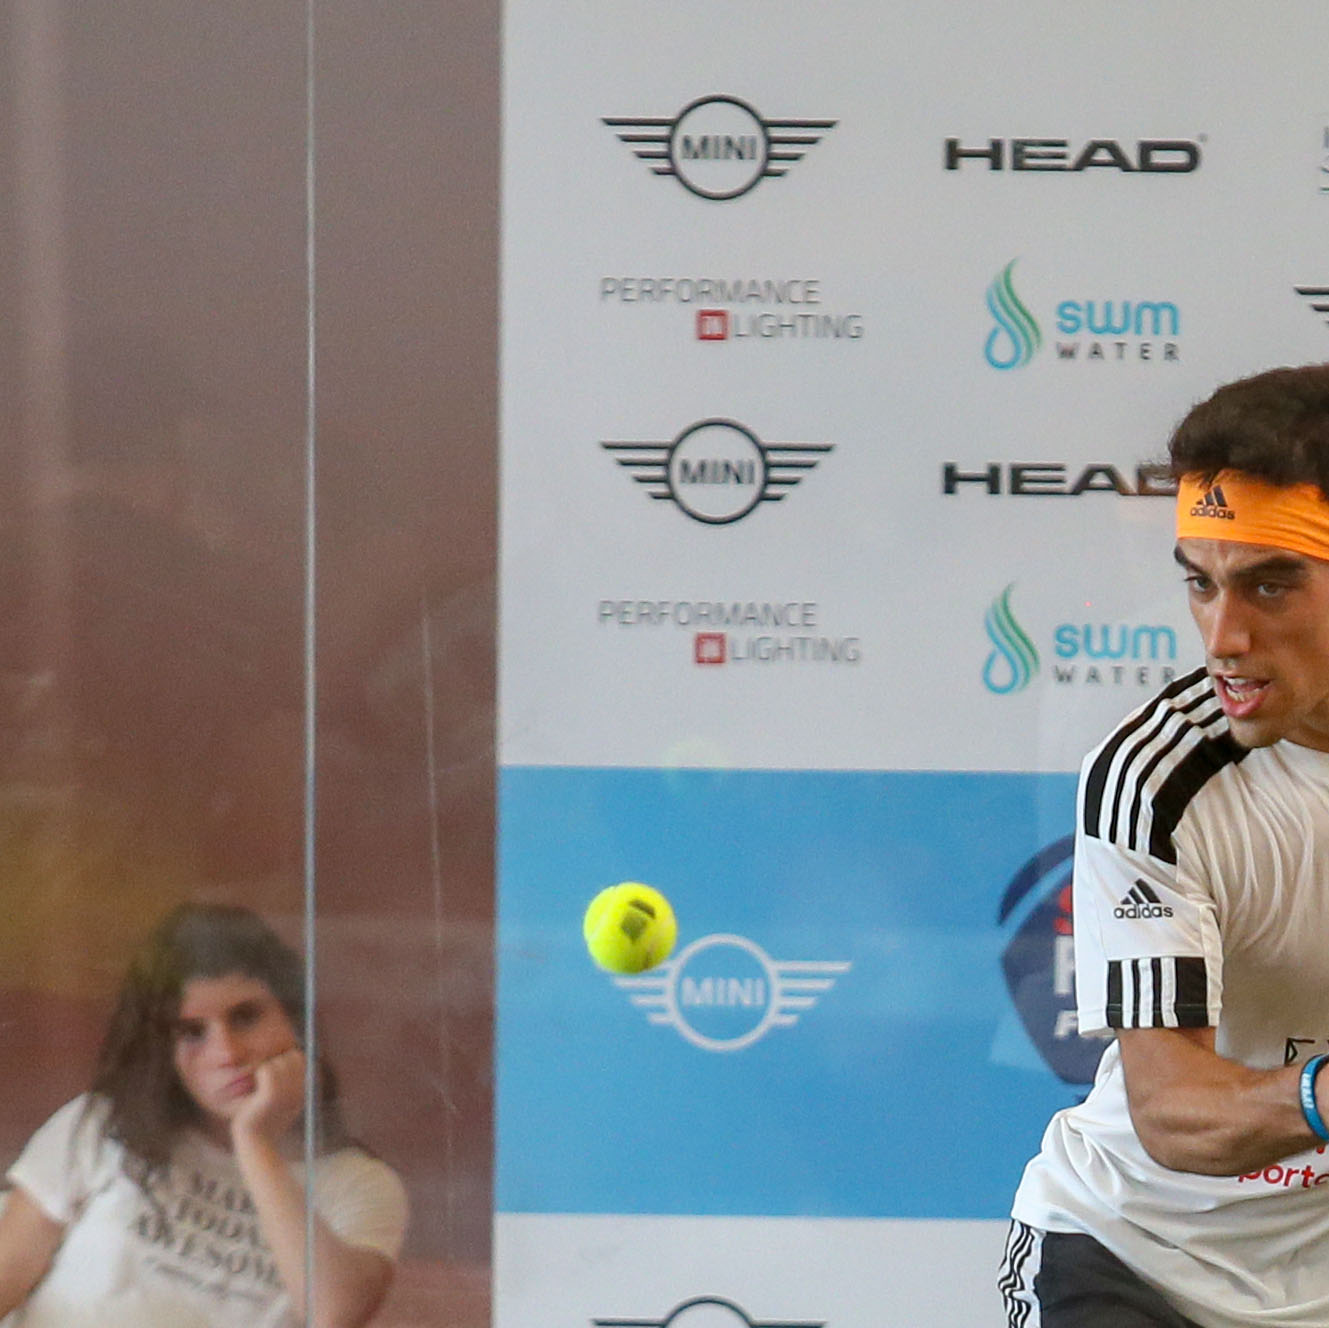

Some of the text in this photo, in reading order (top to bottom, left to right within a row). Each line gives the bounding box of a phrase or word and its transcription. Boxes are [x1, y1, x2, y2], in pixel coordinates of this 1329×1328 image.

[681, 135, 758, 160] MINI
[945, 138, 1202, 173] HEAD
[601, 277, 820, 304] PERFORMANCE
[733, 314, 863, 339] LIGHTING
[1057, 342, 1180, 361] WATER
[679, 460, 755, 485] MINI
[1190, 505, 1235, 520] adidas
[599, 601, 816, 628] PERFORMANCE
[731, 637, 860, 663] LIGHTING
[1054, 666, 1177, 686] WATER
[1114, 905, 1173, 920] adidas
[681, 978, 765, 1009] MINI
